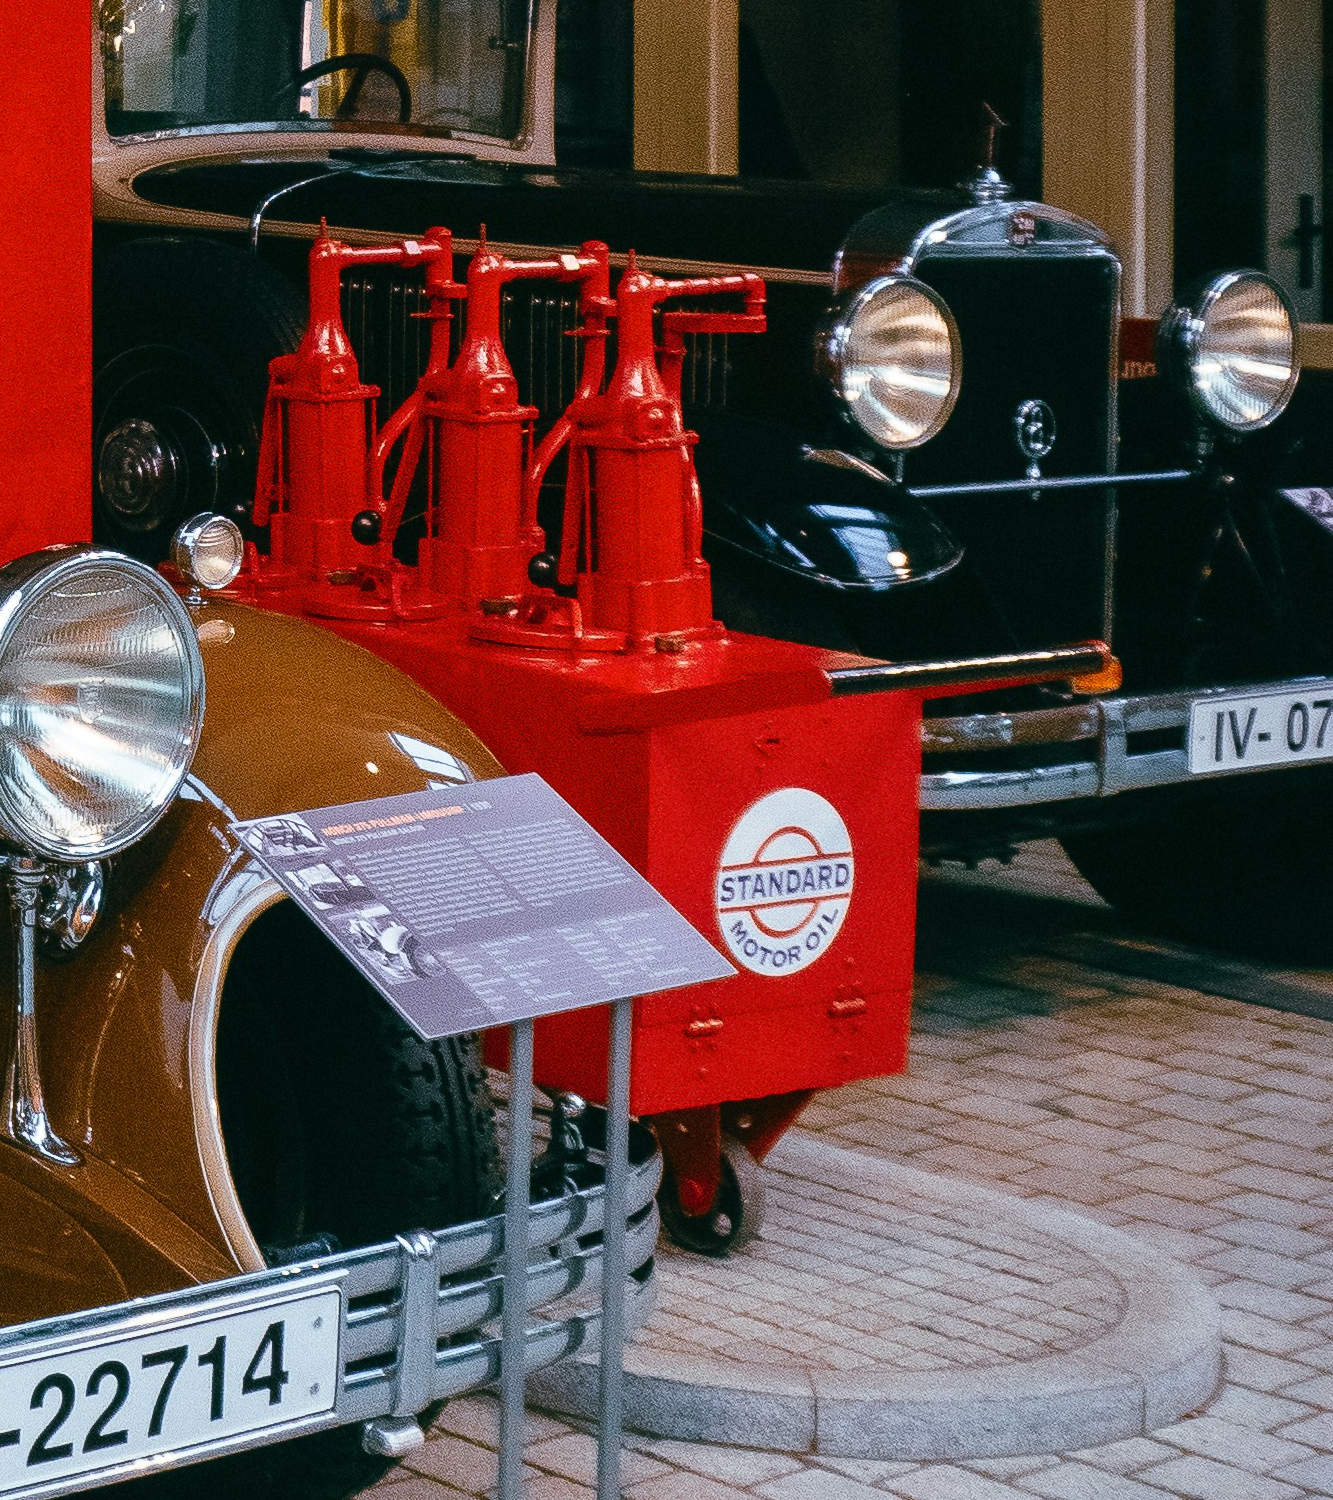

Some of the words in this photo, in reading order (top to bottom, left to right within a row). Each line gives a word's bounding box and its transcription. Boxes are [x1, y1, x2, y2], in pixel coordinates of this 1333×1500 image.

[721, 863, 850, 902] STANDARD
[730, 918, 801, 967] MOTOR
[805, 908, 839, 950] OIL
